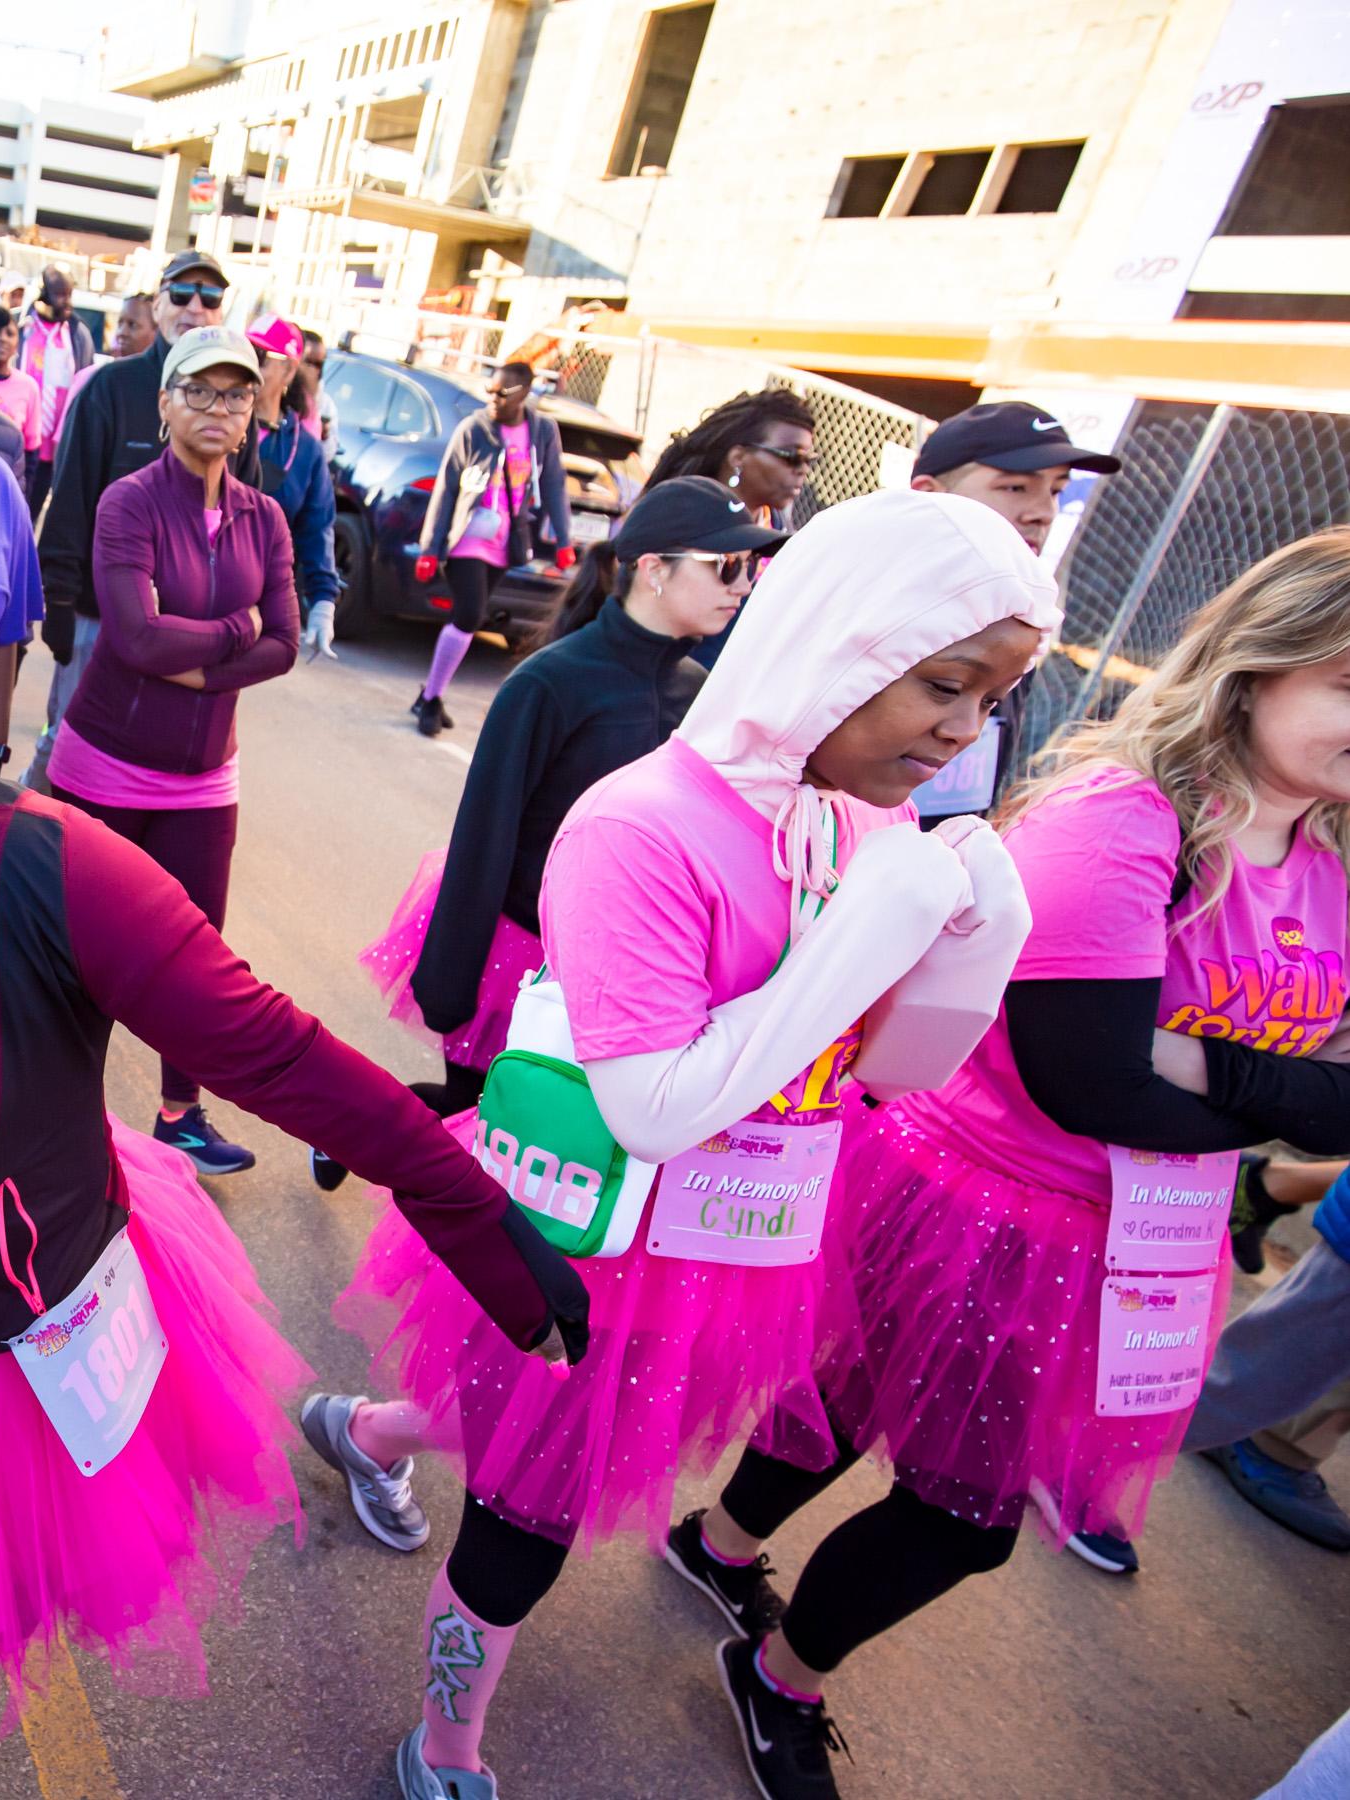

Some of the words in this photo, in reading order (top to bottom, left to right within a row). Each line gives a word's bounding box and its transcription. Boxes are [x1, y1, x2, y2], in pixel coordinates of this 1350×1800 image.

[1199, 948, 1347, 1025] Walk
[476, 1119, 603, 1226] 1908
[681, 1170, 711, 1191] In
[716, 1175, 804, 1203] Memory
[804, 1175, 825, 1200] Of
[1130, 1184, 1149, 1205] In
[1154, 1185, 1216, 1209] Memory
[1216, 1187, 1229, 1208] Of
[700, 1197, 796, 1239] Cyndi
[1140, 1220, 1202, 1240] Grandma
[59, 1283, 151, 1424] 1801
[1124, 1330, 1143, 1351] In
[1145, 1330, 1185, 1350] Honor
[1186, 1325, 1200, 1346] Of
